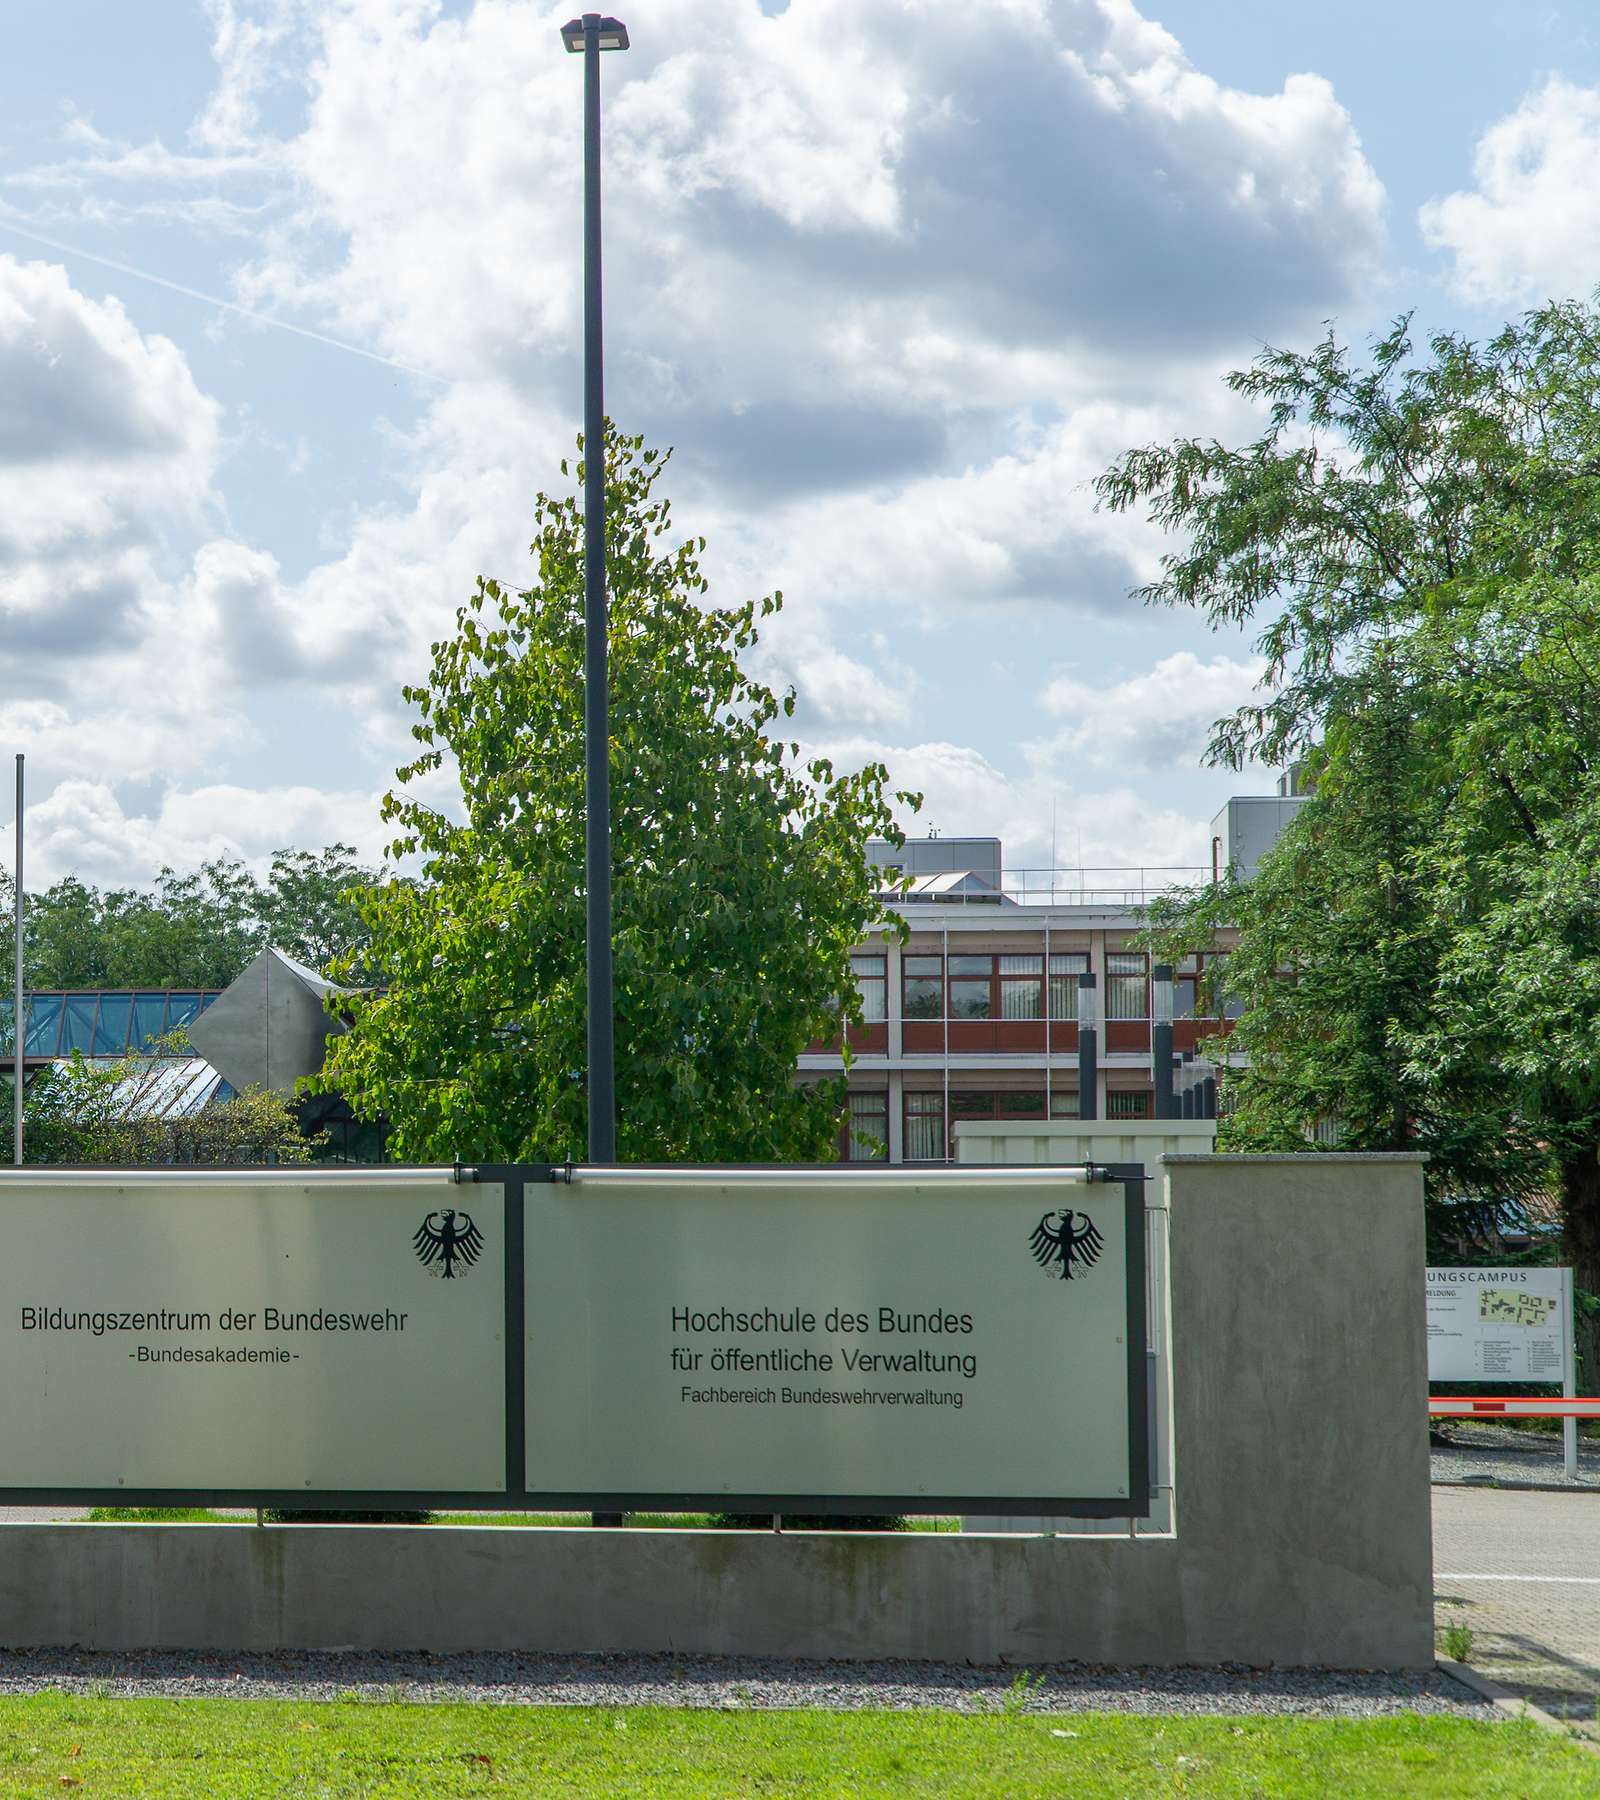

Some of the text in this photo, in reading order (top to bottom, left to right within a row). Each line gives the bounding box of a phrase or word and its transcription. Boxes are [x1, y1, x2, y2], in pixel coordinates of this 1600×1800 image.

[1427, 1272, 1527, 1283] UNGSCAMPUS
[21, 1306, 409, 1337] Bildungszentrum der Bundeswehr
[671, 1306, 974, 1334] Hochschule des Bundes
[670, 1347, 977, 1379] für öffentliche Verwaltung
[681, 1386, 963, 1410] Fachbereich Bundeswehrverwaltung
